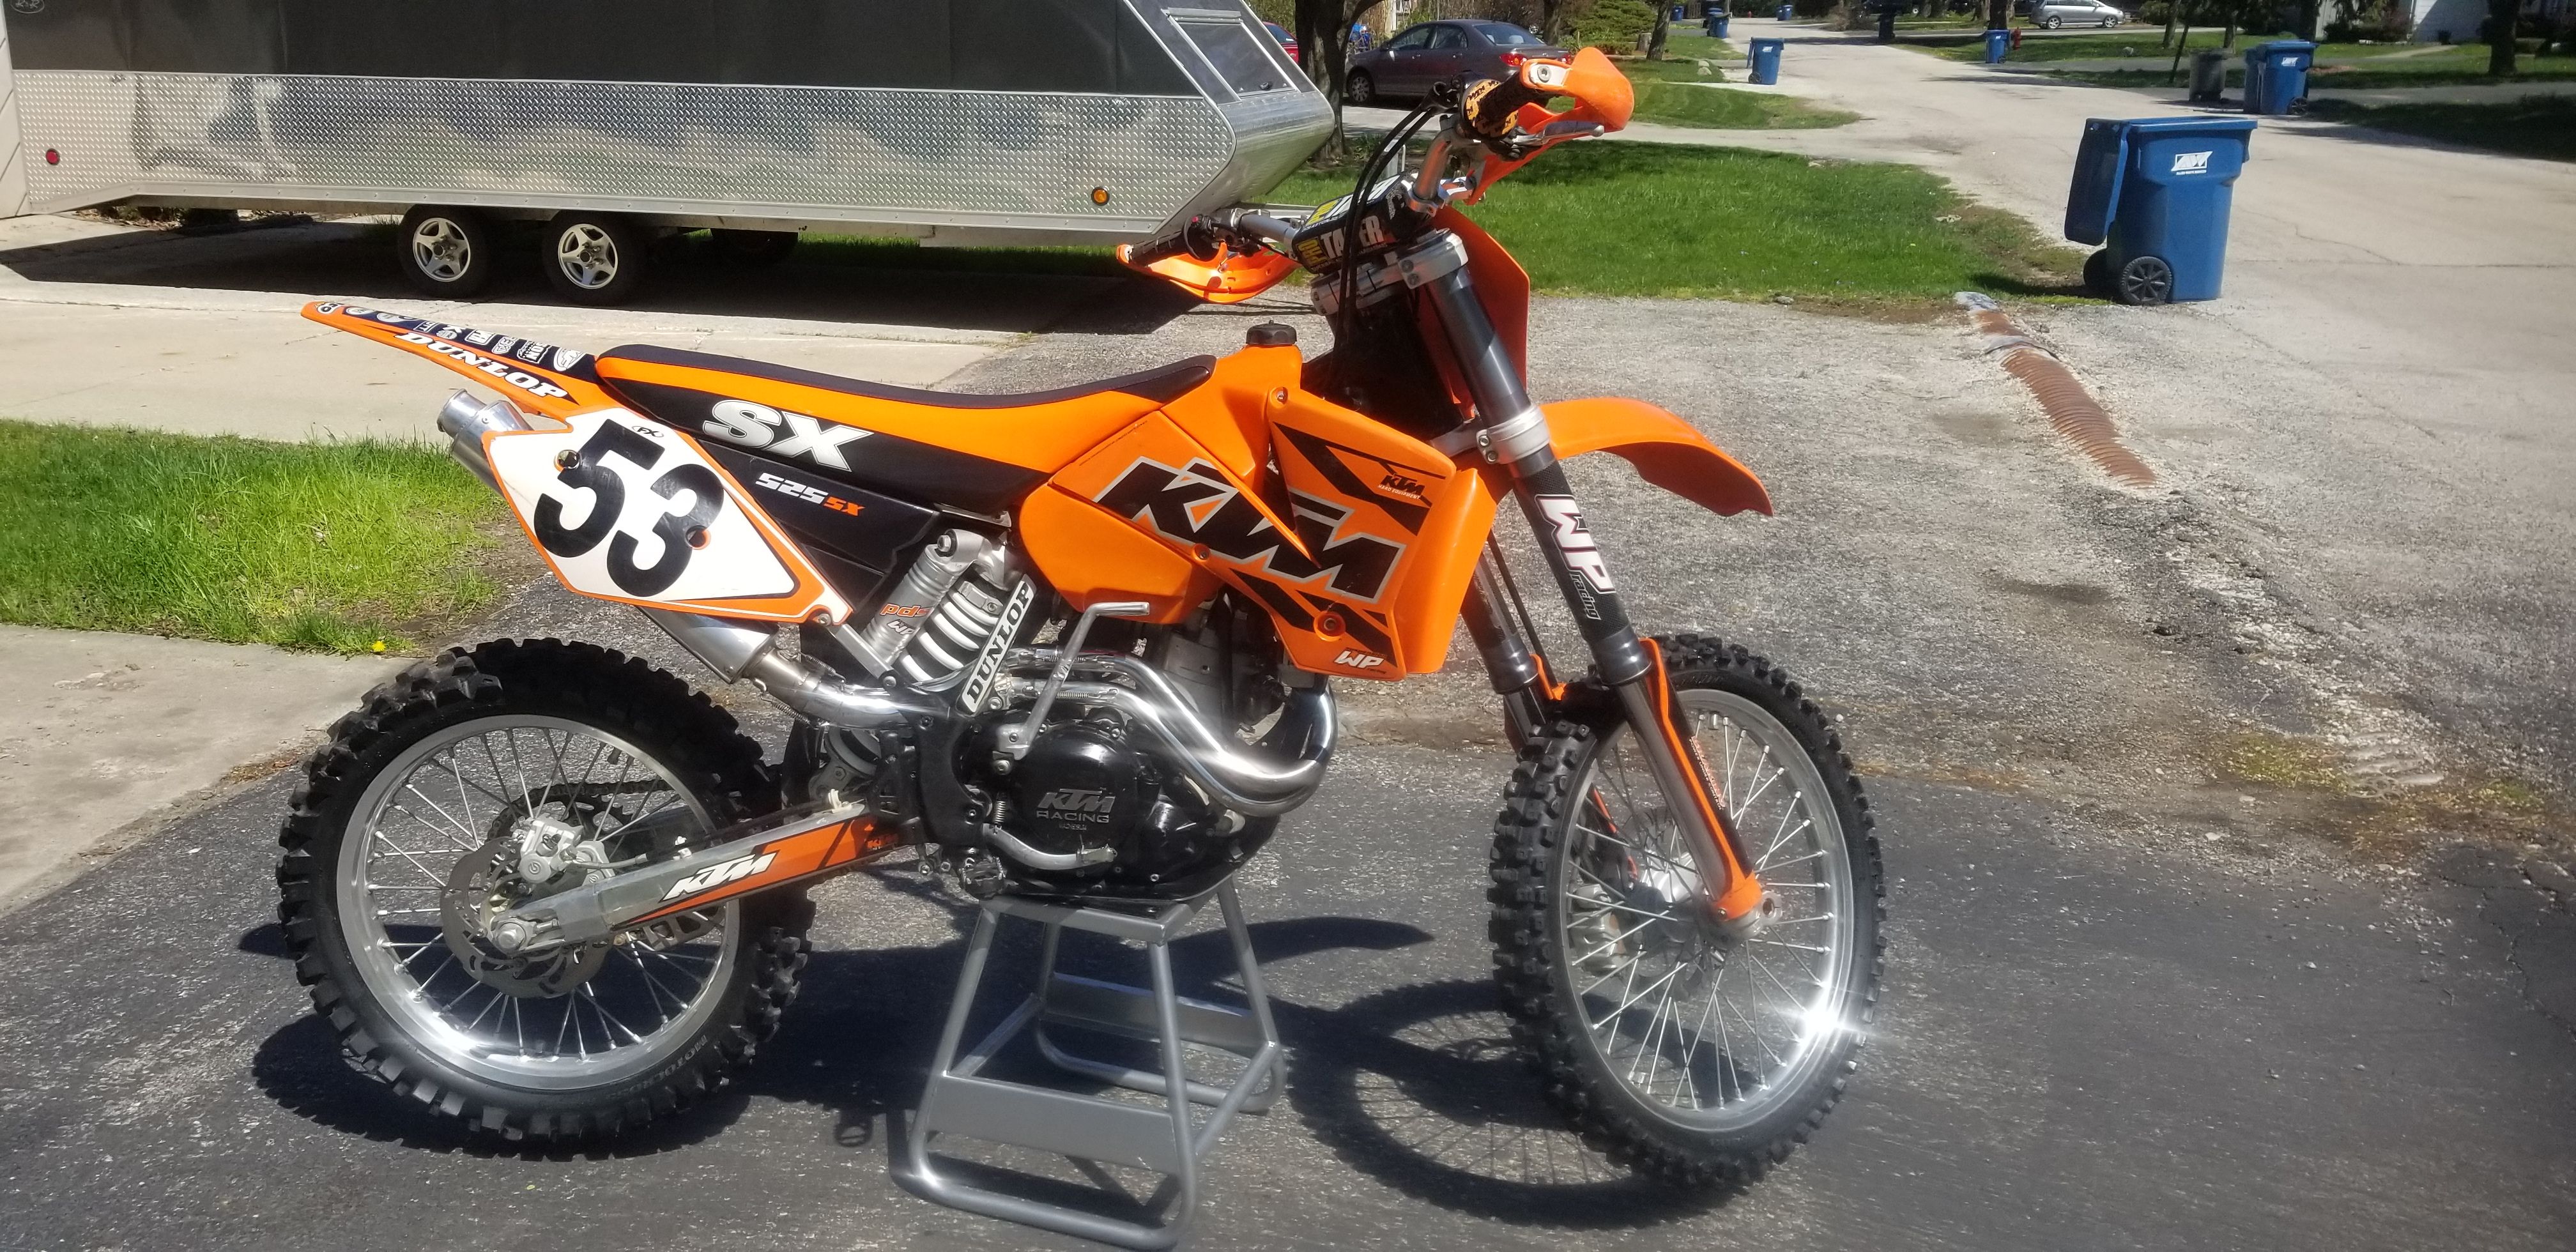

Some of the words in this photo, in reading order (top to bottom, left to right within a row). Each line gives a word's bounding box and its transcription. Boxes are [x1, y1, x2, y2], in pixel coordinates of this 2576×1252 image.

[1321, 215, 1384, 258] TAER
[394, 332, 568, 399] DUNLOP
[703, 399, 874, 472] SX
[533, 418, 724, 597] 53
[1380, 475, 1425, 496] KTM
[1092, 455, 1407, 604] KTM
[1537, 497, 1616, 592] WP
[1571, 574, 1601, 621] racing
[966, 583, 1031, 704] DUNLOP
[1333, 650, 1385, 669] WP
[1036, 810, 1110, 823] RACING
[1037, 788, 1116, 813] KTM
[661, 852, 778, 901] KTM
